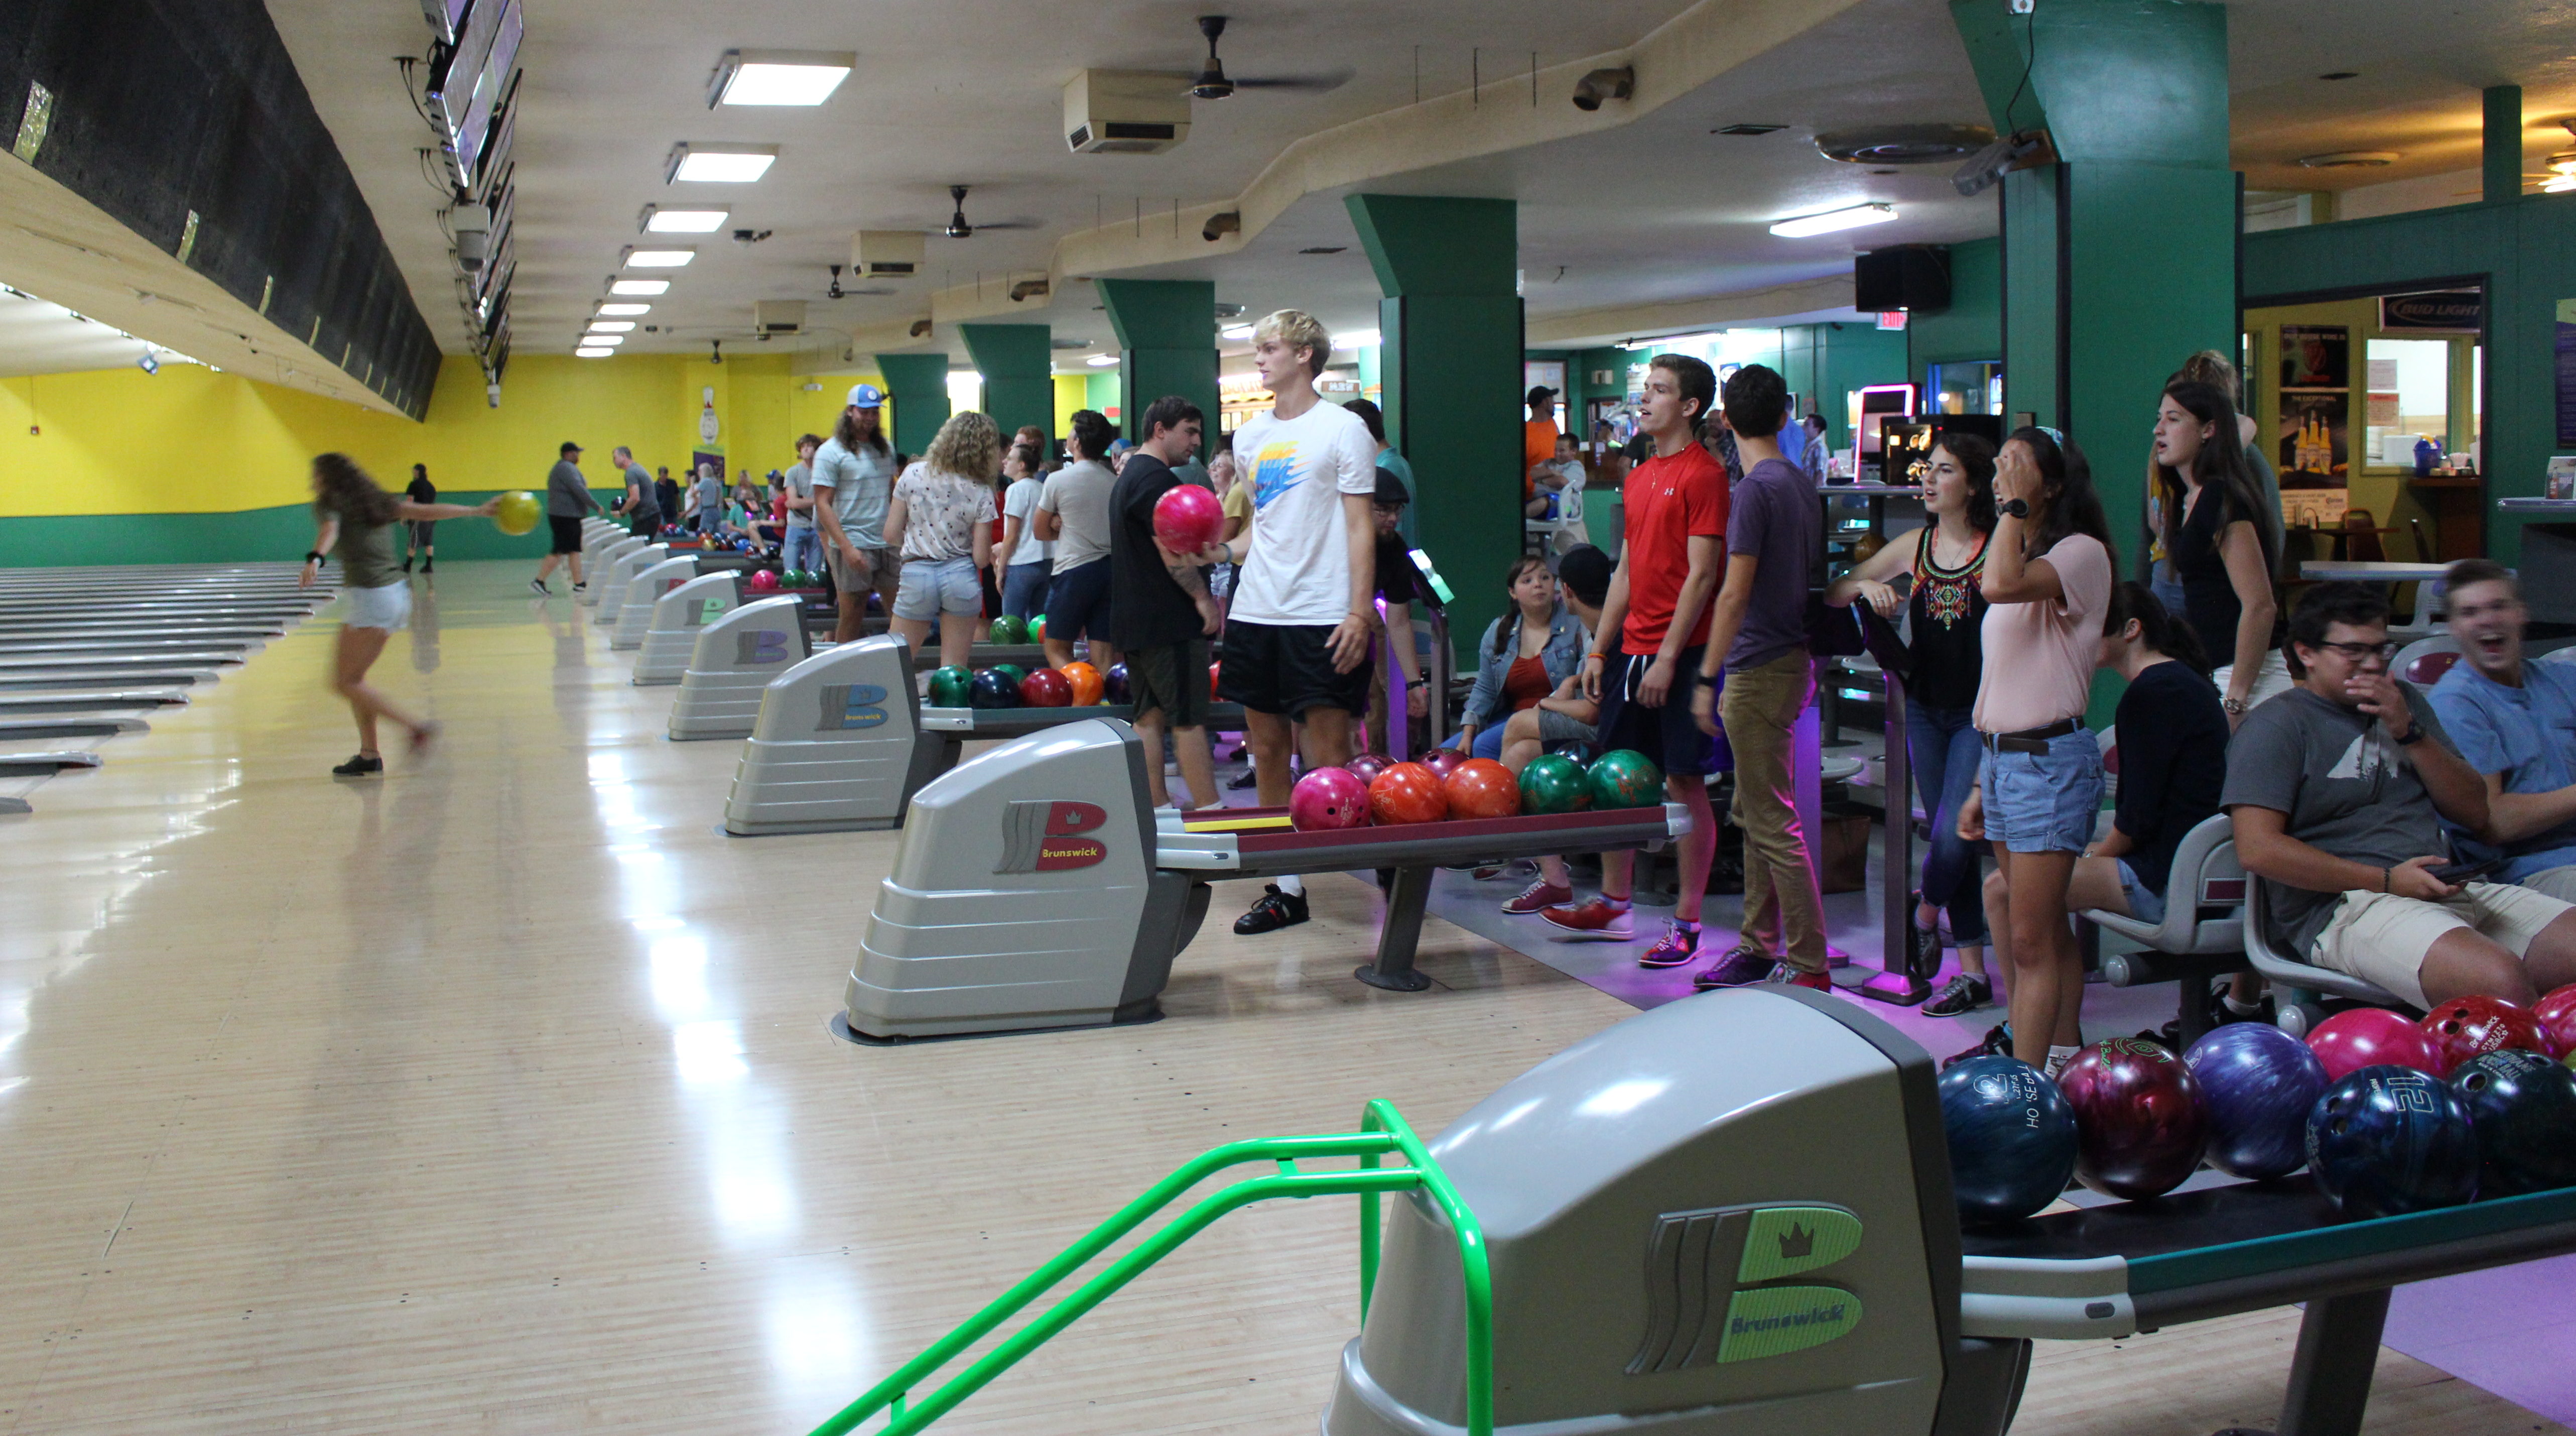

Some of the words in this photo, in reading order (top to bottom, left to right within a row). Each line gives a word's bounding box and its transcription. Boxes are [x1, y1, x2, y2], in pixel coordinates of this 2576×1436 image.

[1042, 847, 1098, 858] Brunswick
[2469, 1015, 2500, 1048] Bruswick
[2387, 1076, 2434, 1113] 12
[1731, 1304, 1845, 1336] Brunswick
